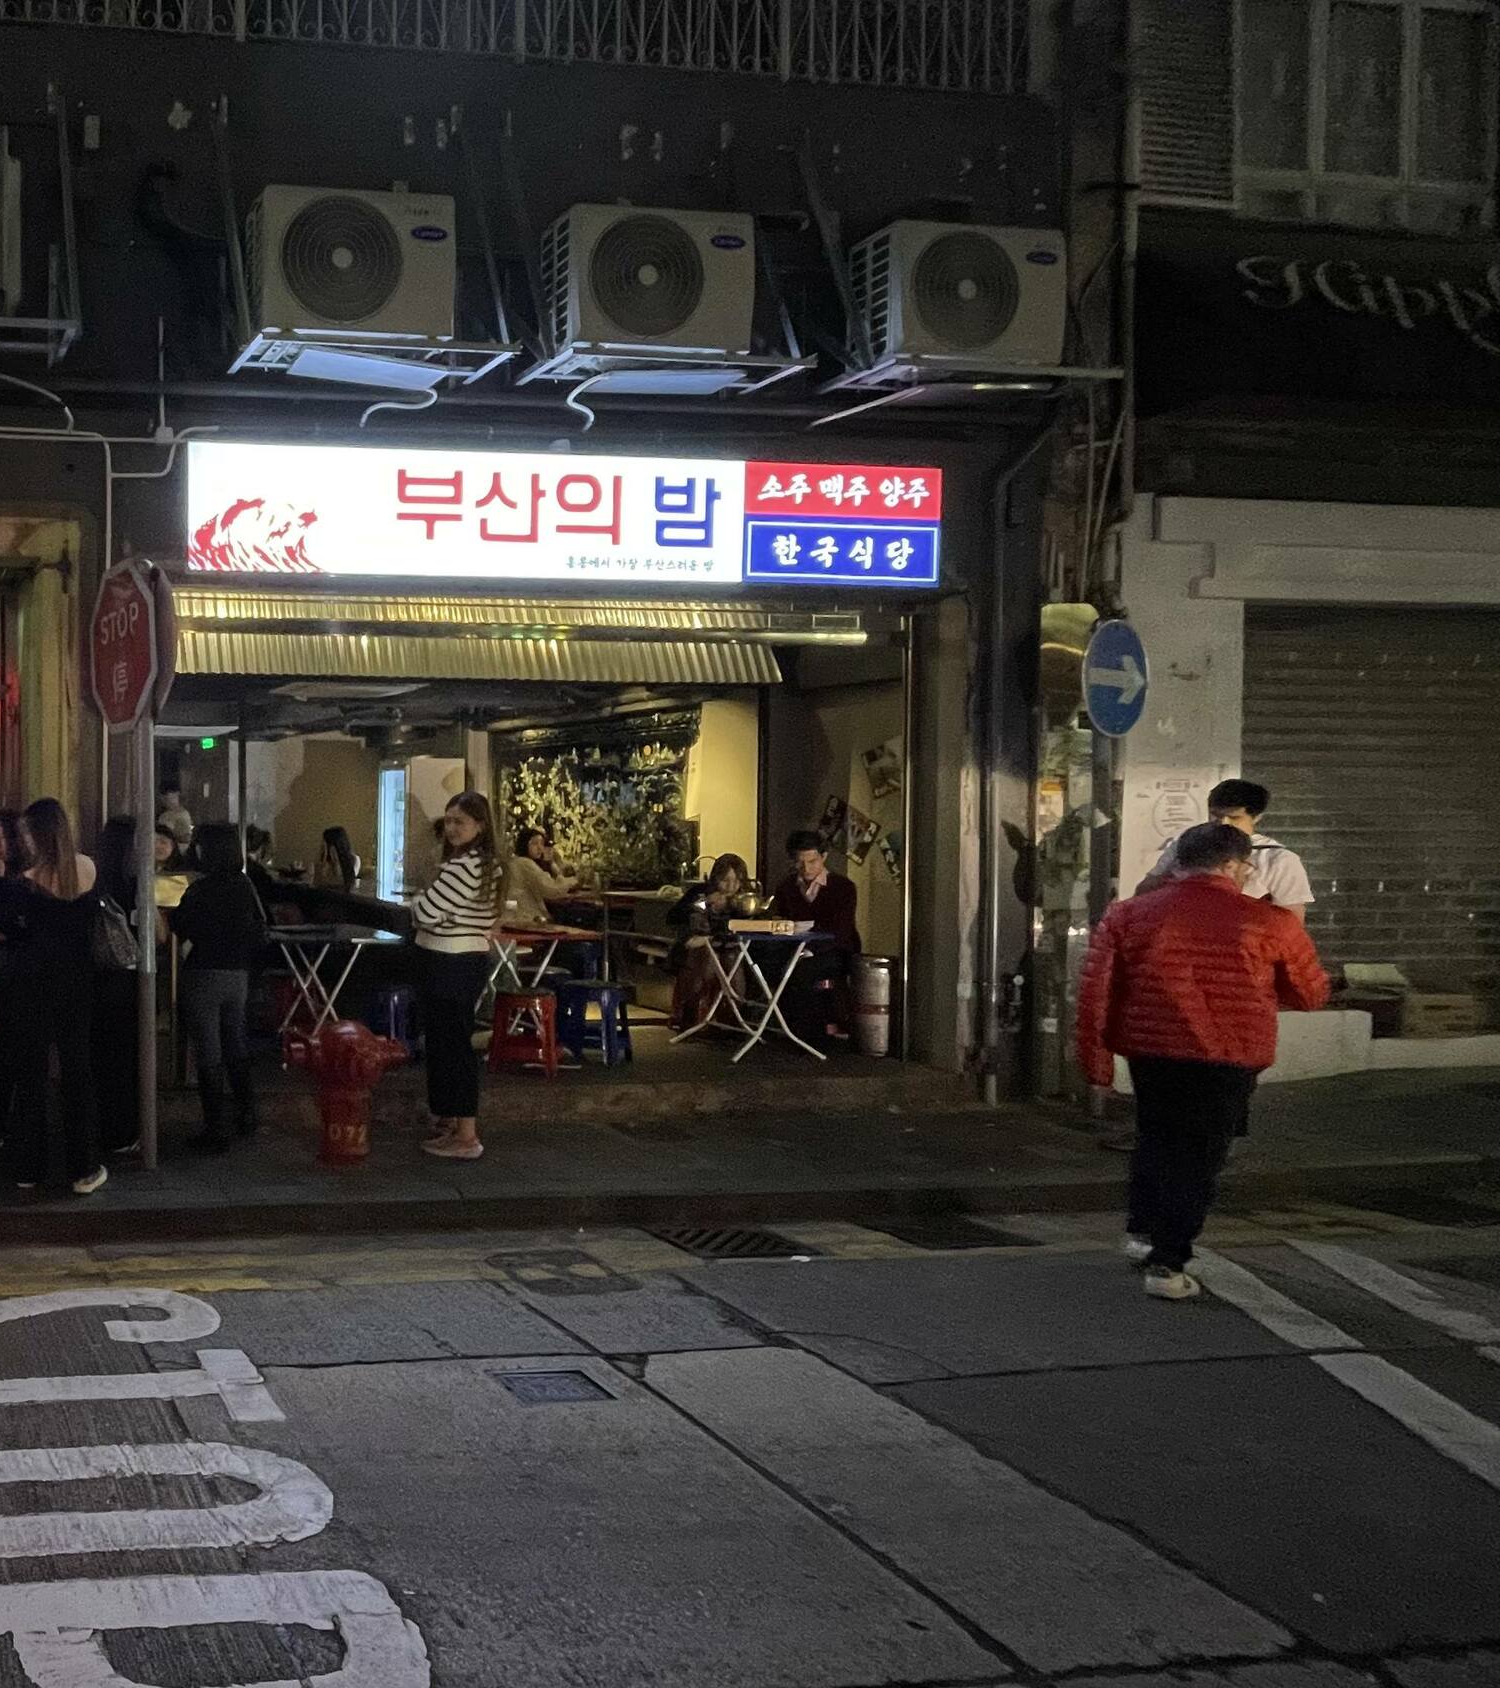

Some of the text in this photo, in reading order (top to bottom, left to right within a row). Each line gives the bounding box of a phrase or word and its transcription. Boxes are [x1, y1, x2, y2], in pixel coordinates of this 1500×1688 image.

[396, 469, 721, 548] 부산의 밤
[757, 473, 930, 508] 소주 맥주 양주
[100, 602, 139, 645] STOP
[112, 660, 129, 703] 停
